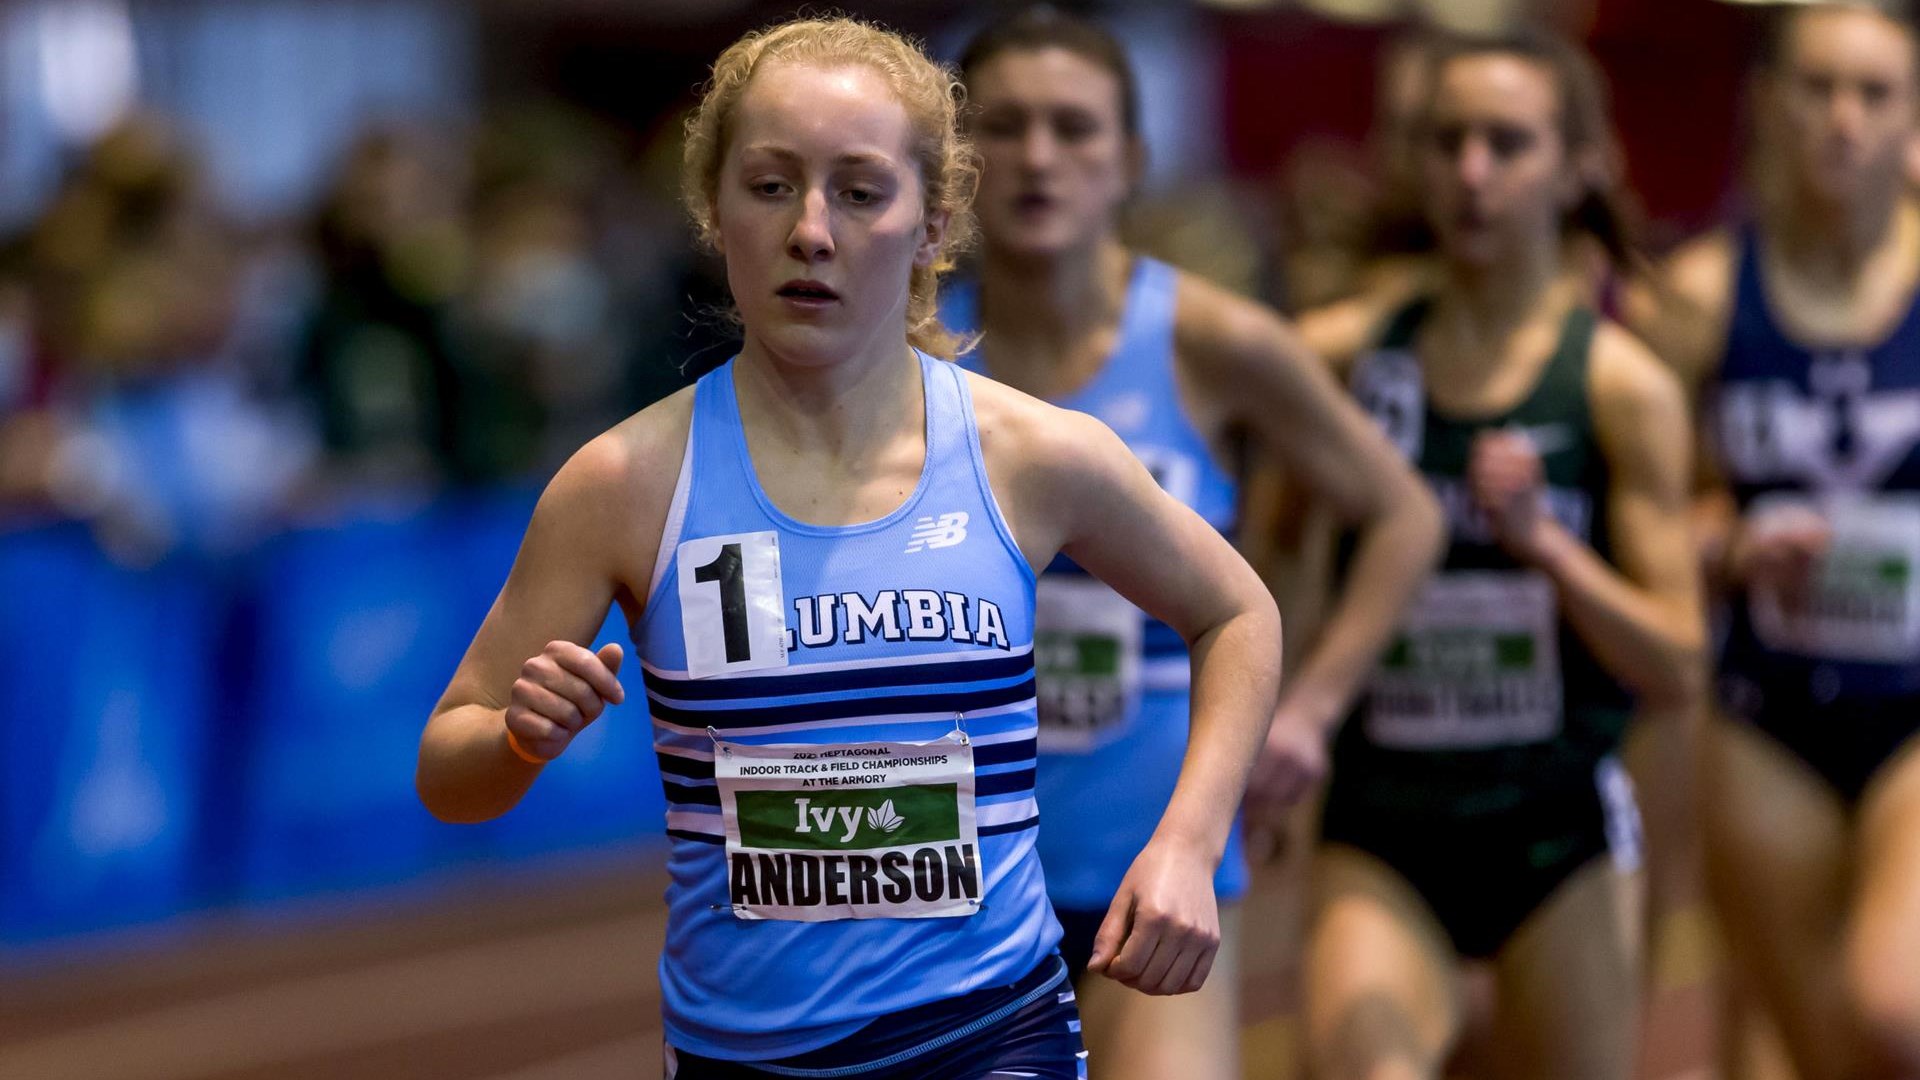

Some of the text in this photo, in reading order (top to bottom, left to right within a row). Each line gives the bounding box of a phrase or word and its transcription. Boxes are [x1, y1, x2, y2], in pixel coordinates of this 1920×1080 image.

[694, 542, 751, 664] 1
[786, 589, 1011, 652] UMBIA
[740, 754, 948, 776] INDOOR TRACK & FIELD CHAMPIONSHIPS
[820, 747, 891, 758] HEPTAGONAL
[803, 774, 887, 787] AT THE ARMORY
[794, 797, 864, 843] Ivy
[731, 843, 978, 907] ANDERSON
